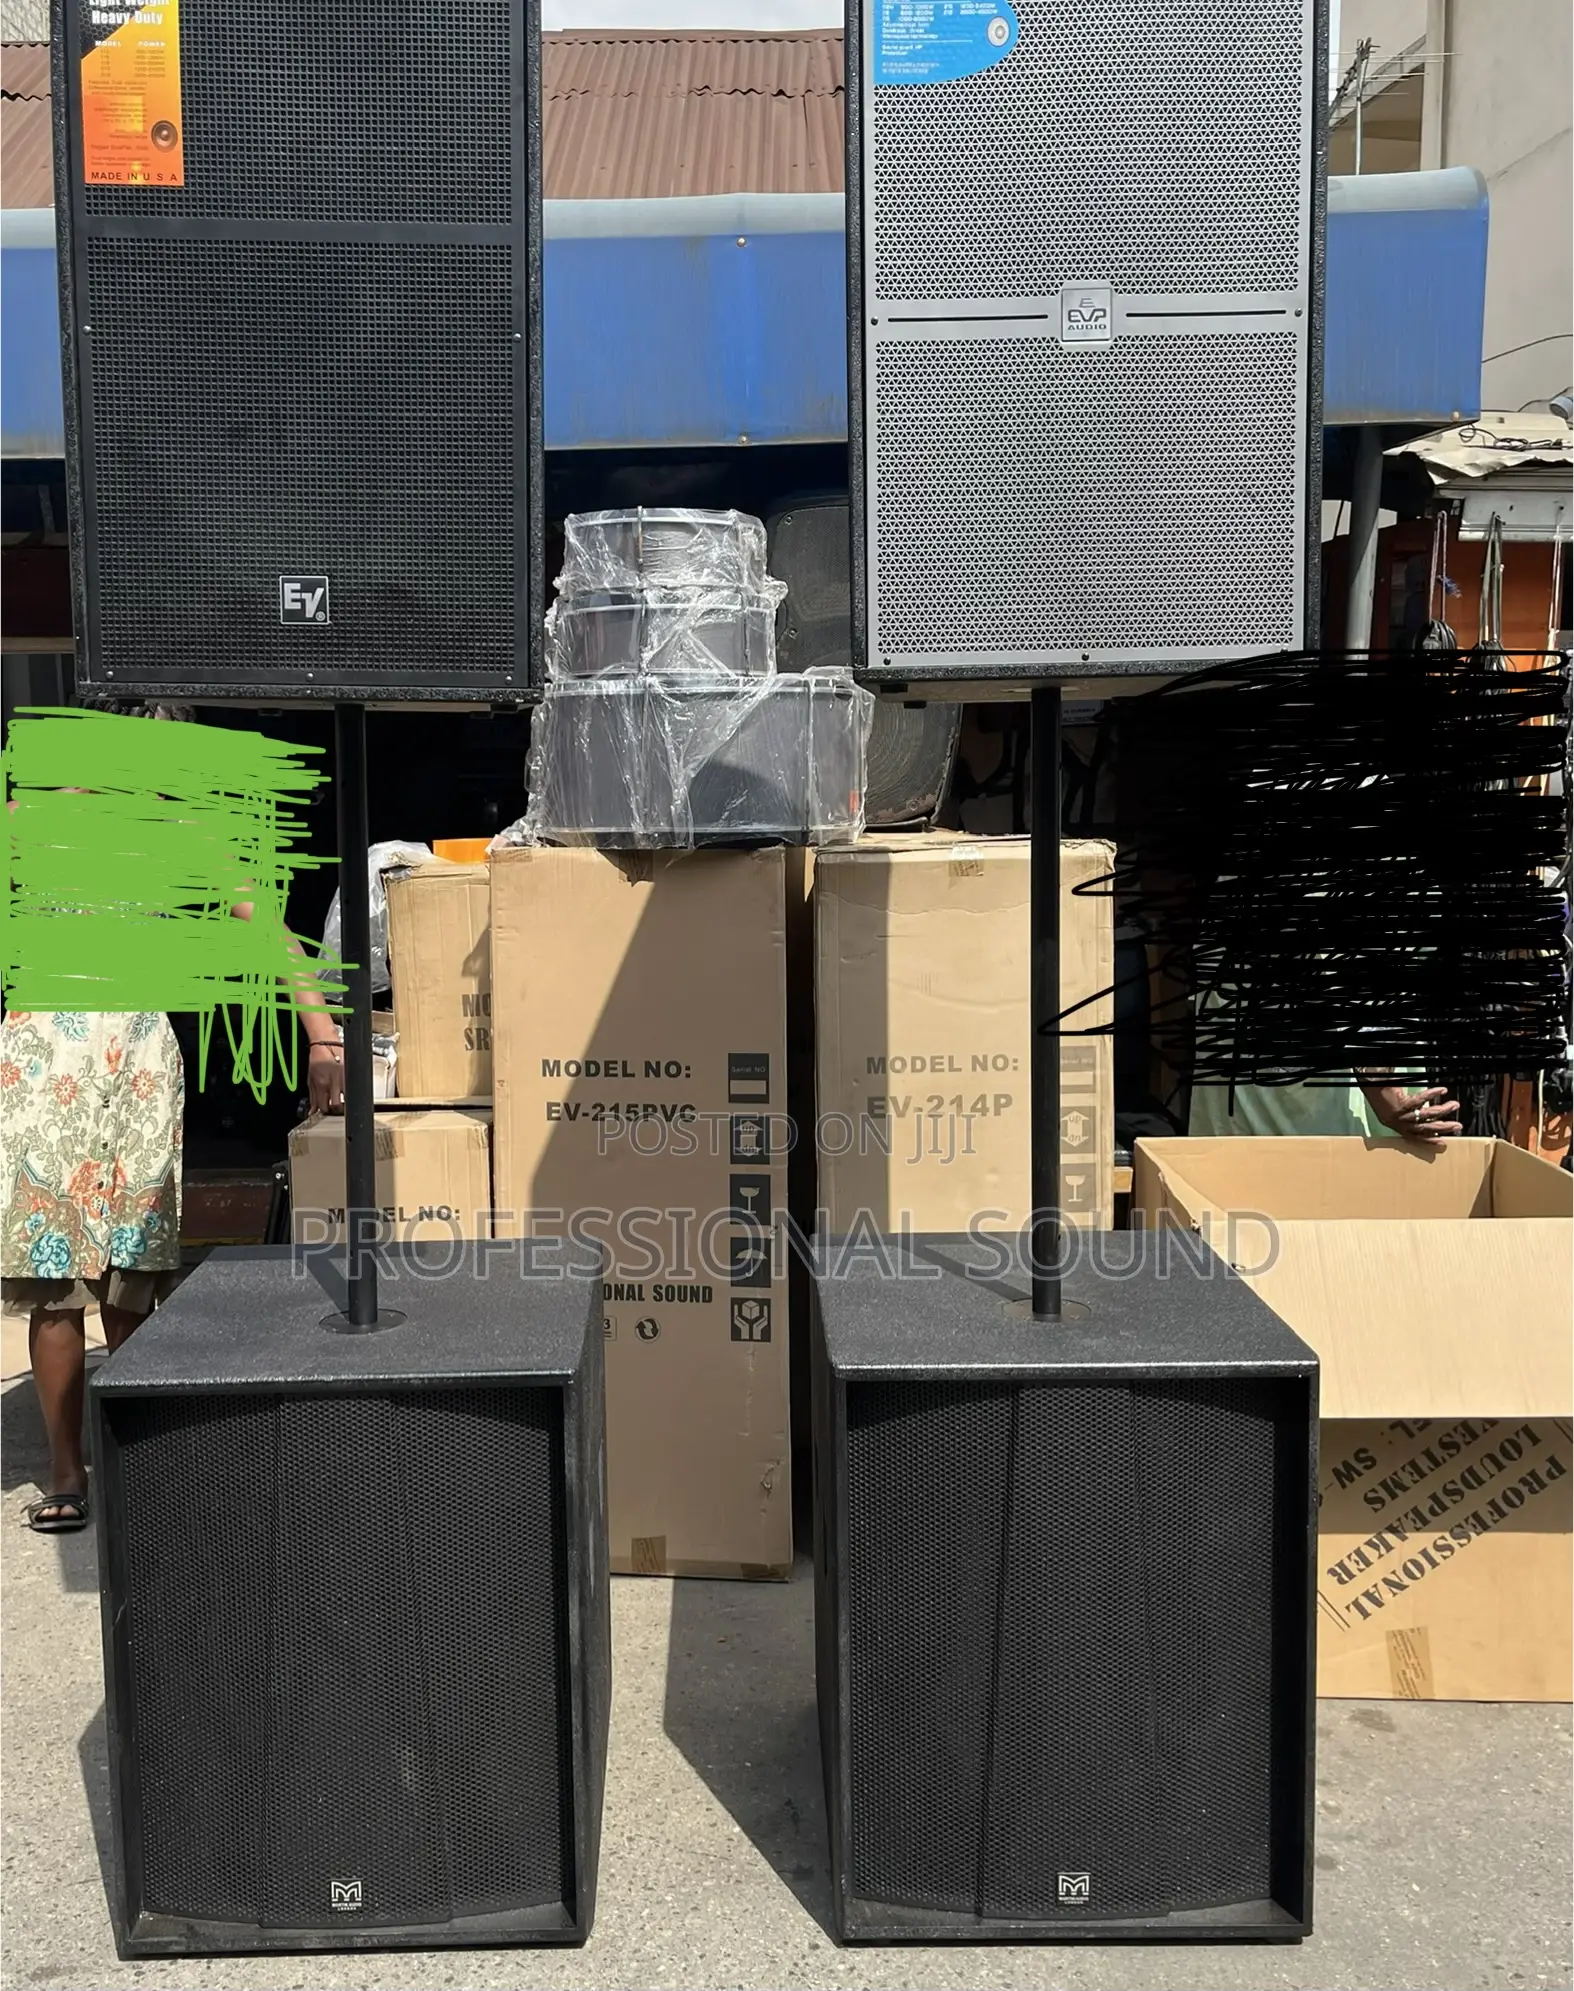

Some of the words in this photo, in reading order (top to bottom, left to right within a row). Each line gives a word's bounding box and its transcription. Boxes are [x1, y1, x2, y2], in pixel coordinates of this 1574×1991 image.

[92, 11, 130, 24] Heavy
[135, 11, 163, 25] Duty
[91, 172, 122, 180] MADE
[128, 173, 137, 181] IN
[143, 173, 150, 181] U
[156, 173, 163, 181] S
[170, 174, 178, 182] A
[1068, 308, 1106, 323] EVP
[541, 1059, 636, 1078] MODEL
[644, 1060, 692, 1079] NO:
[866, 1055, 962, 1075] MODEL
[971, 1054, 1019, 1072] NO:
[866, 1093, 1014, 1119] EV-214P
[1068, 1115, 1082, 1124] up
[653, 1284, 713, 1303] SOUND
[1326, 1423, 1542, 1586] LOUDSPEAKER
[1344, 1454, 1567, 1621] PROFESSIONAL
